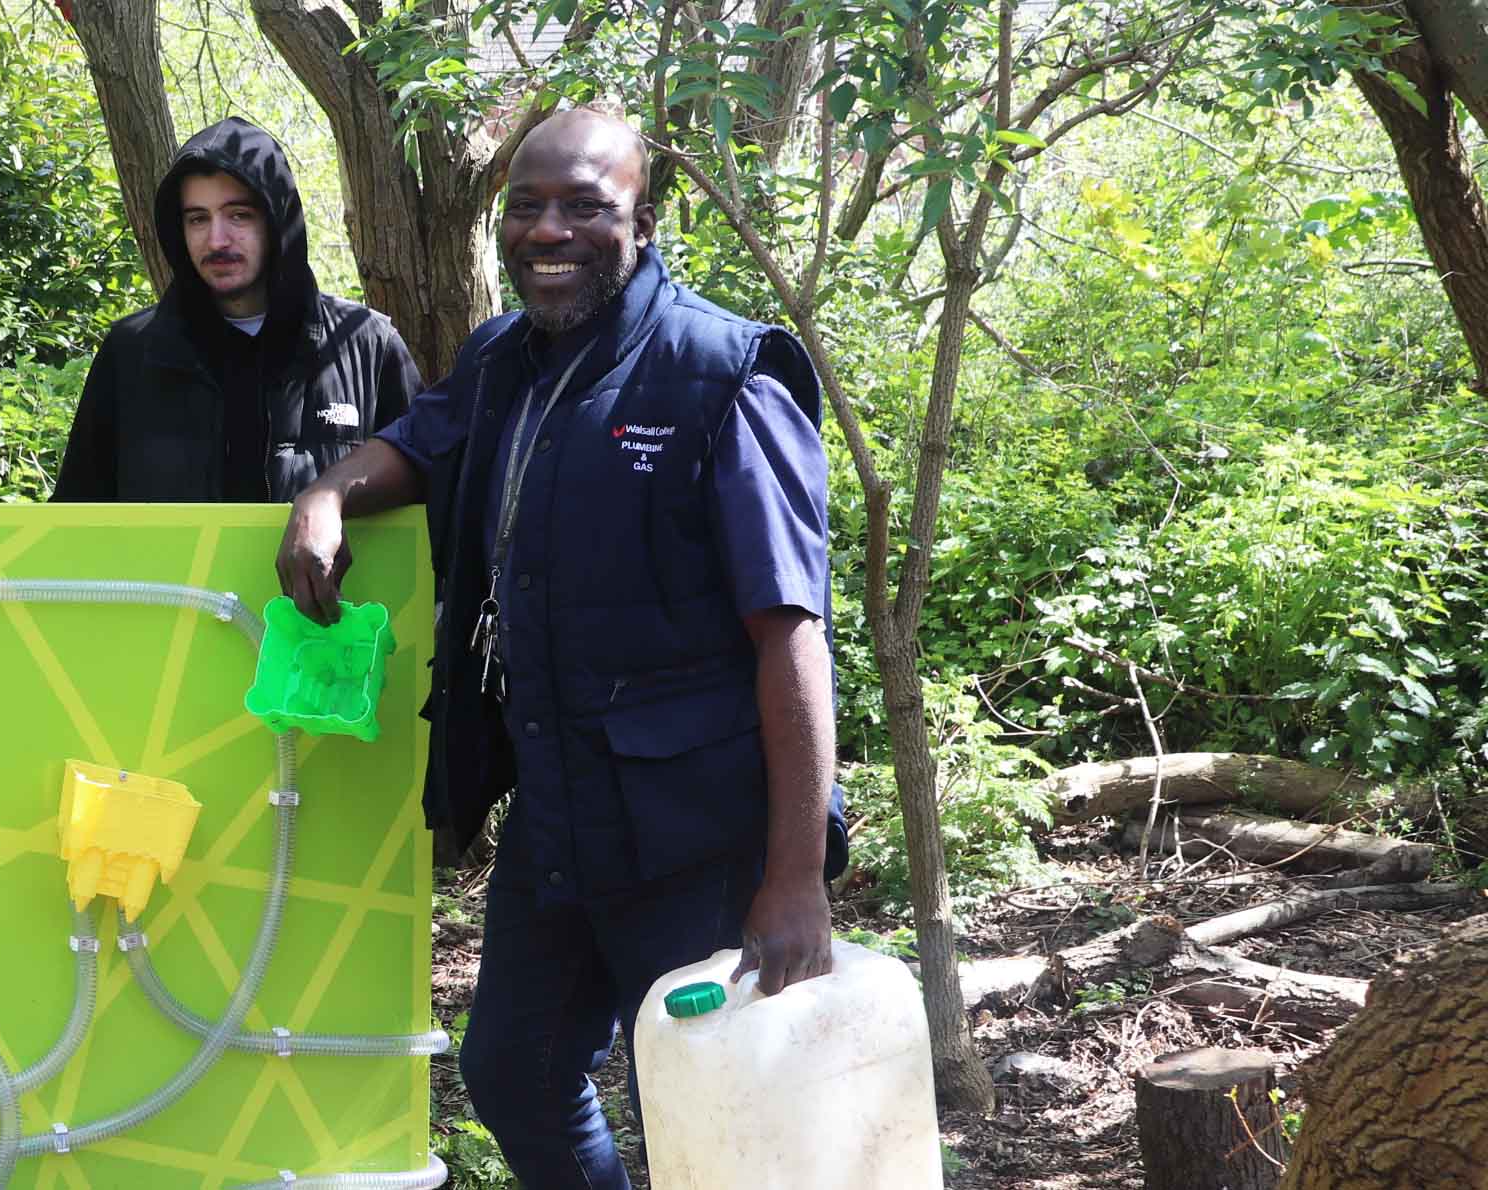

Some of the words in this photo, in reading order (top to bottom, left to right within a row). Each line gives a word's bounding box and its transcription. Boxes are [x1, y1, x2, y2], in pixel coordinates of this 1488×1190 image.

[625, 424, 655, 436] Walsall
[655, 426, 675, 437] Coll
[640, 453, 647, 461] &
[633, 462, 654, 472] GAS
